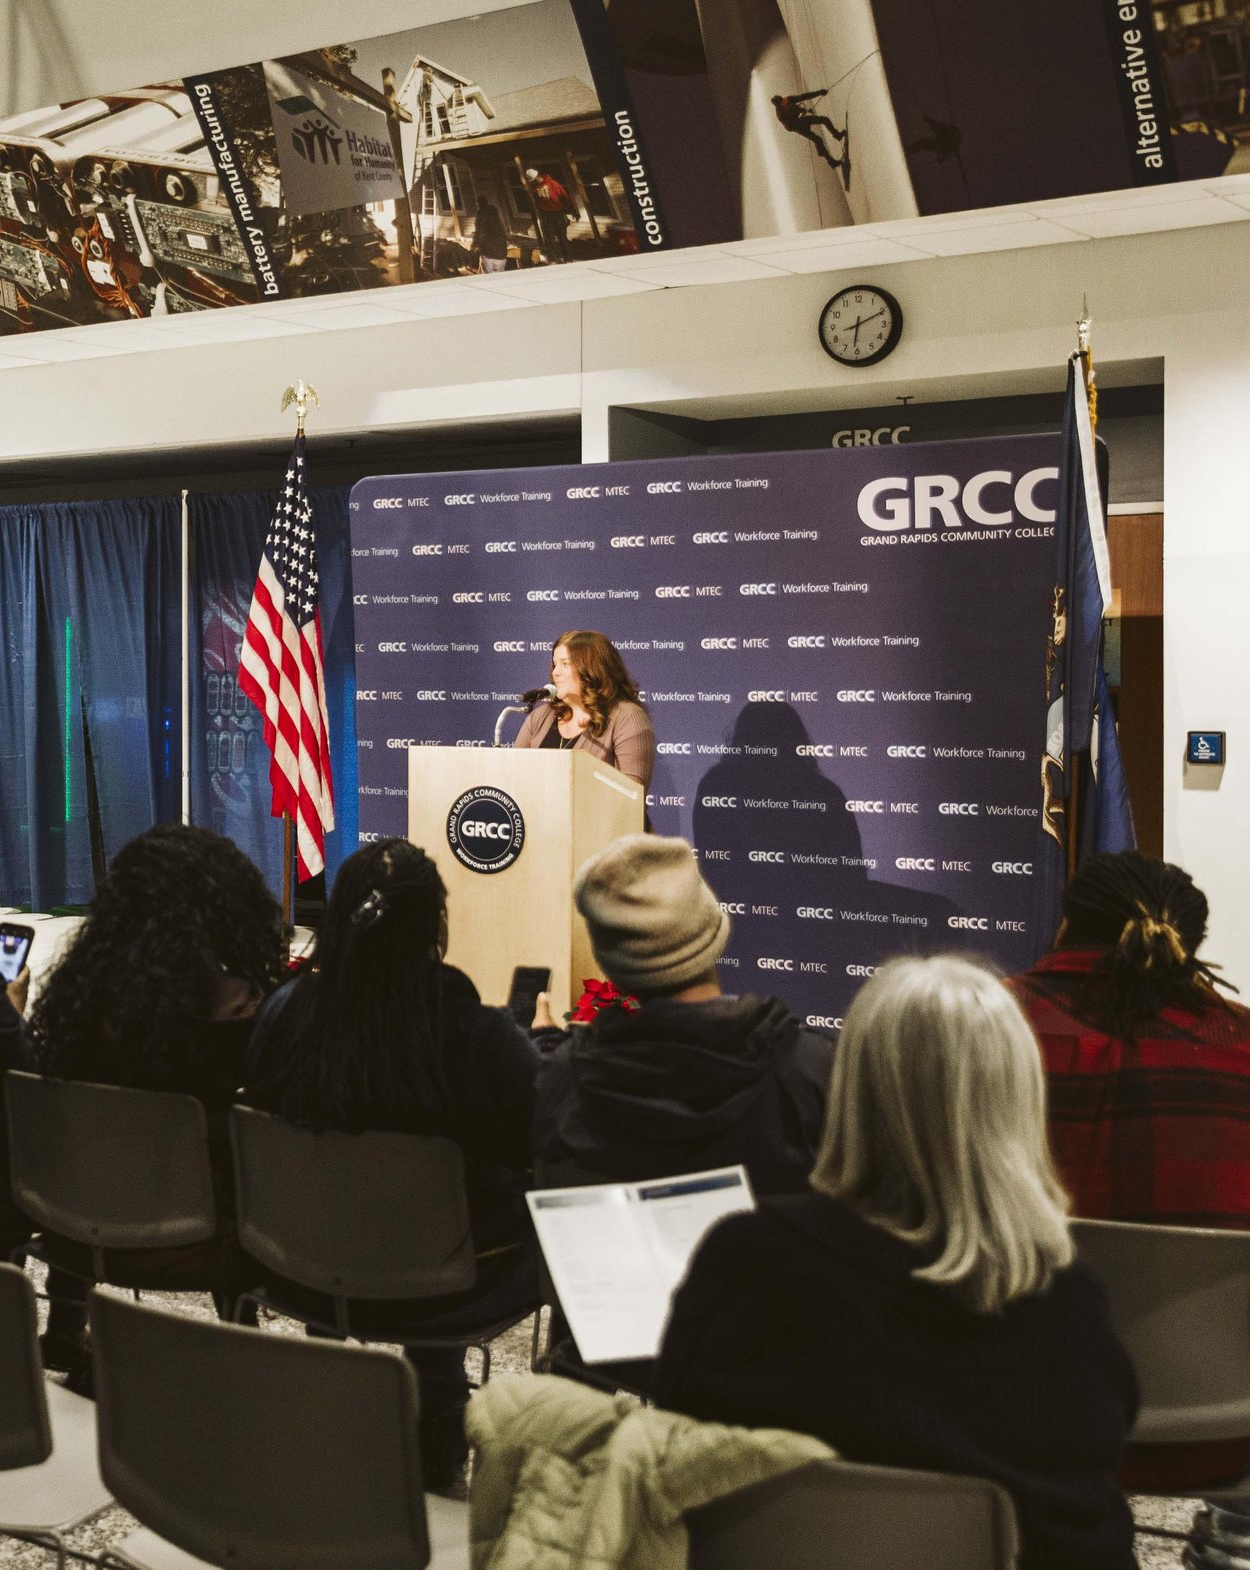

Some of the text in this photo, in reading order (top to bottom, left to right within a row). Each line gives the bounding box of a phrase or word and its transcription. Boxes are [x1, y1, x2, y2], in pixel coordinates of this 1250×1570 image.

[1121, 29, 1163, 168] alternative
[345, 130, 393, 158] Habitat
[351, 154, 396, 172] for Humanity
[614, 110, 662, 245] construction
[194, 84, 279, 296] battery manufacturing
[842, 300, 849, 308] 11
[854, 295, 863, 303] 12
[832, 311, 841, 319] 10
[830, 324, 836, 332] 9
[833, 335, 838, 343] 8
[877, 332, 883, 340] 4
[854, 347, 860, 355] 6
[832, 426, 911, 448] GRCC
[566, 486, 630, 499] GRCC MTEC
[647, 478, 770, 494] GRCC Workforce Training
[373, 497, 429, 509] GRCC MTEC
[444, 491, 552, 505] GRCC Workforce Training
[857, 467, 1059, 532] GRCC
[610, 535, 675, 548] GRCC MTEC
[692, 529, 819, 544] GRCC Workforce Training
[860, 535, 899, 546] GRAND
[901, 533, 939, 544] RAPIDS
[941, 529, 1012, 542] COMMUNITY
[371, 547, 399, 557] Training
[412, 544, 470, 556] GRCC MTEC
[485, 540, 596, 553] GRCC Workforce Training
[655, 585, 722, 598] GRCC MTEC
[739, 581, 870, 596] GRCC Workforce Training
[372, 595, 409, 604] Workforce
[410, 594, 439, 605] Training
[452, 592, 511, 603] GRCC MTEC
[526, 589, 640, 602] GRCC Workforce Training
[378, 642, 479, 653] GRCC Workforce Training
[493, 641, 553, 652] GRCC MTEC
[651, 640, 685, 651] Training
[701, 637, 769, 650] GRCC MTEC
[787, 635, 921, 648] GRCC Workforce Training
[356, 690, 403, 701] RCC MTEC
[417, 690, 519, 702] GRCC Workforce Training
[651, 691, 696, 701] Workforce
[697, 692, 732, 704] Training
[747, 690, 819, 702] GRCC MTEC
[836, 690, 972, 703] GRCC Workforce Training
[387, 738, 415, 749] GRCC
[656, 742, 778, 757] GRCC Workforce Training
[795, 744, 868, 757] GRCC MTEC
[887, 745, 1026, 761] GRCC Workforce Training
[358, 786, 382, 795] rkforce
[660, 794, 687, 808] MTEC
[702, 796, 827, 812] GRCC Workforce Training
[845, 800, 918, 814] GRCC MTEC
[938, 802, 1038, 817] GRCC Workforce
[449, 789, 522, 848] GRAND RAPIDS COMMUNITY COLLEGE
[461, 820, 510, 840] GRCC
[358, 832, 378, 842] RCC
[456, 847, 514, 870] WORKFORCE TRAINING
[705, 850, 730, 860] MTEC
[748, 850, 878, 870] GRCC Workforce Training
[895, 857, 971, 872] GRCC MTEC
[991, 861, 1033, 875] GRCC
[719, 903, 778, 916] RCC MTEC
[796, 906, 928, 927] GRCC Workforce Training
[947, 916, 1026, 932] GRCC MTEC
[757, 957, 827, 973] GRCC MTEC
[806, 1015, 843, 1029] GRCC
